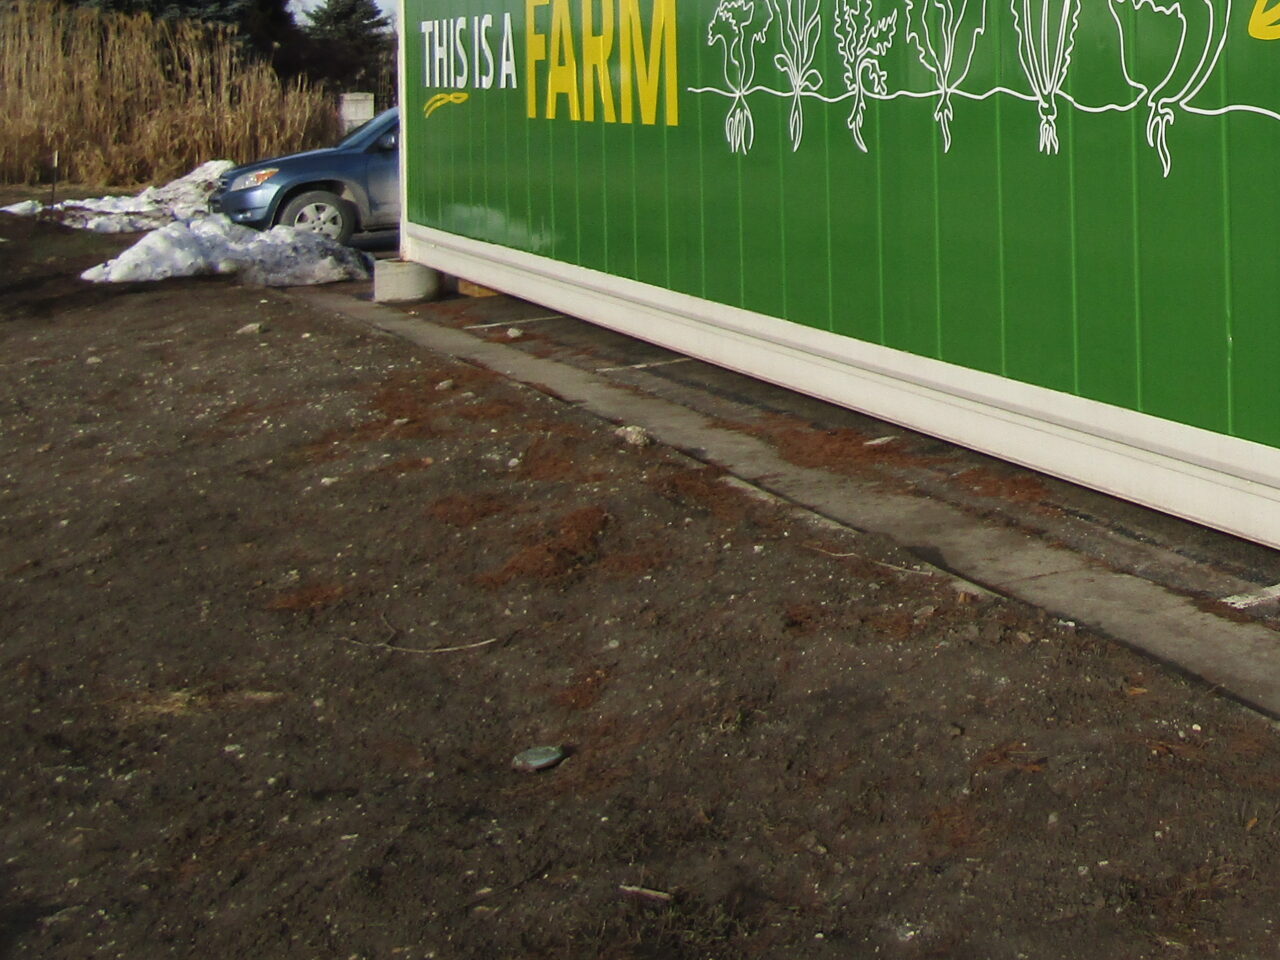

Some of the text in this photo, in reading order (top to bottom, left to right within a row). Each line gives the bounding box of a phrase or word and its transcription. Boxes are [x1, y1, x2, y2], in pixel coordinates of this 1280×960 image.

[421, 16, 468, 89] THIS
[474, 13, 494, 89] IS
[500, 12, 518, 89] A
